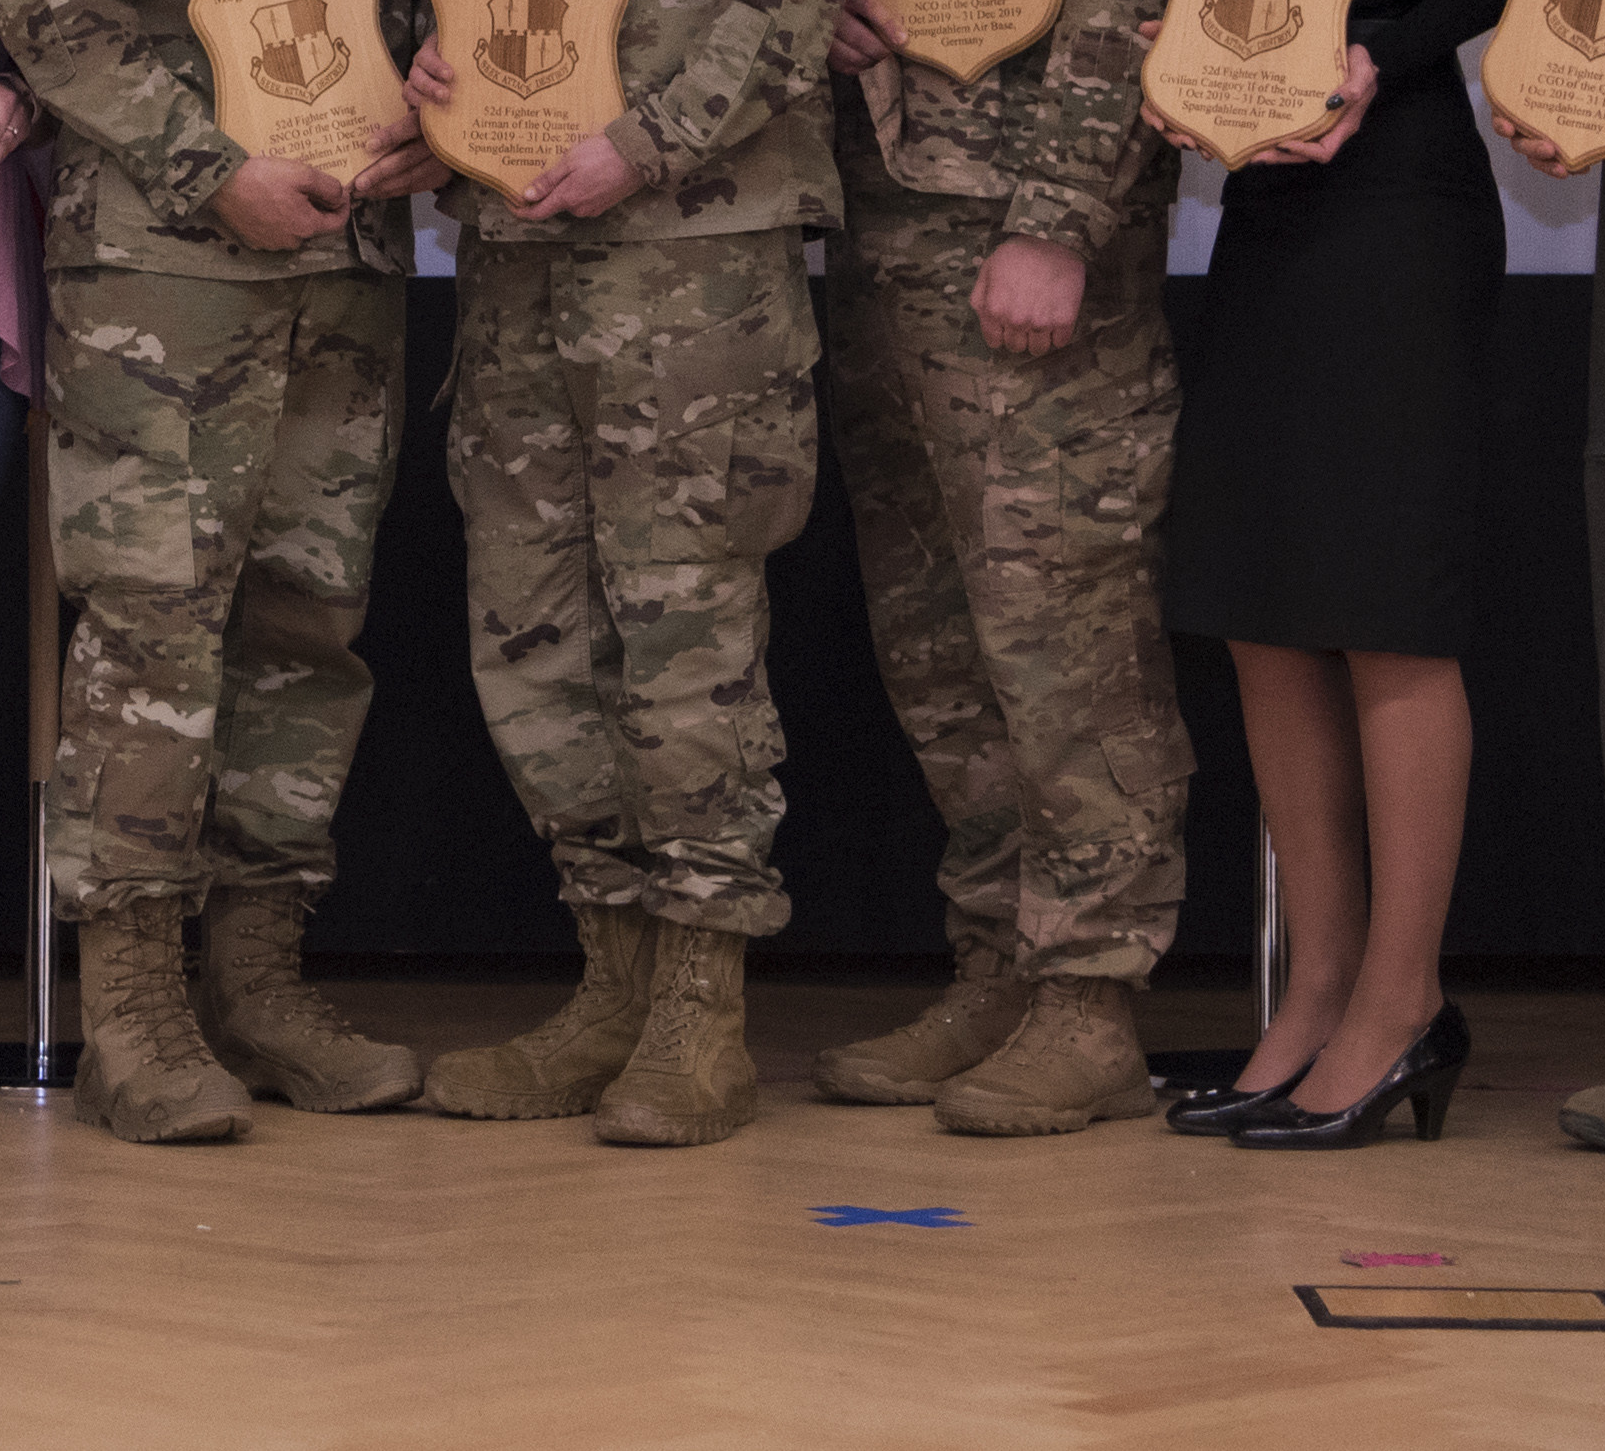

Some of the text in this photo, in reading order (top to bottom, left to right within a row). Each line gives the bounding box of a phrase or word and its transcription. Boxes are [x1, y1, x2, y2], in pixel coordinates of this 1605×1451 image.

[1202, 66, 1285, 83] 52d Fighter Wing
[1159, 73, 1197, 86] Civilian
[1200, 78, 1244, 93] Category
[1271, 85, 1285, 94] the
[1288, 87, 1325, 99] Quarter
[1186, 88, 1203, 99] Oct
[1206, 90, 1230, 101] 2019
[1256, 94, 1276, 106] Dec
[1279, 96, 1303, 108] 2019
[484, 106, 568, 121] 52d Fighter Wing
[1249, 108, 1265, 118] Air
[472, 119, 579, 131] Airman of the Quarter
[1214, 116, 1259, 131] Germany
[470, 131, 487, 140] Oct
[491, 131, 515, 141] 2019
[542, 132, 561, 142] Dec
[468, 143, 533, 154] Spangdahlem
[536, 144, 553, 154] Air
[502, 156, 546, 167] Germany
